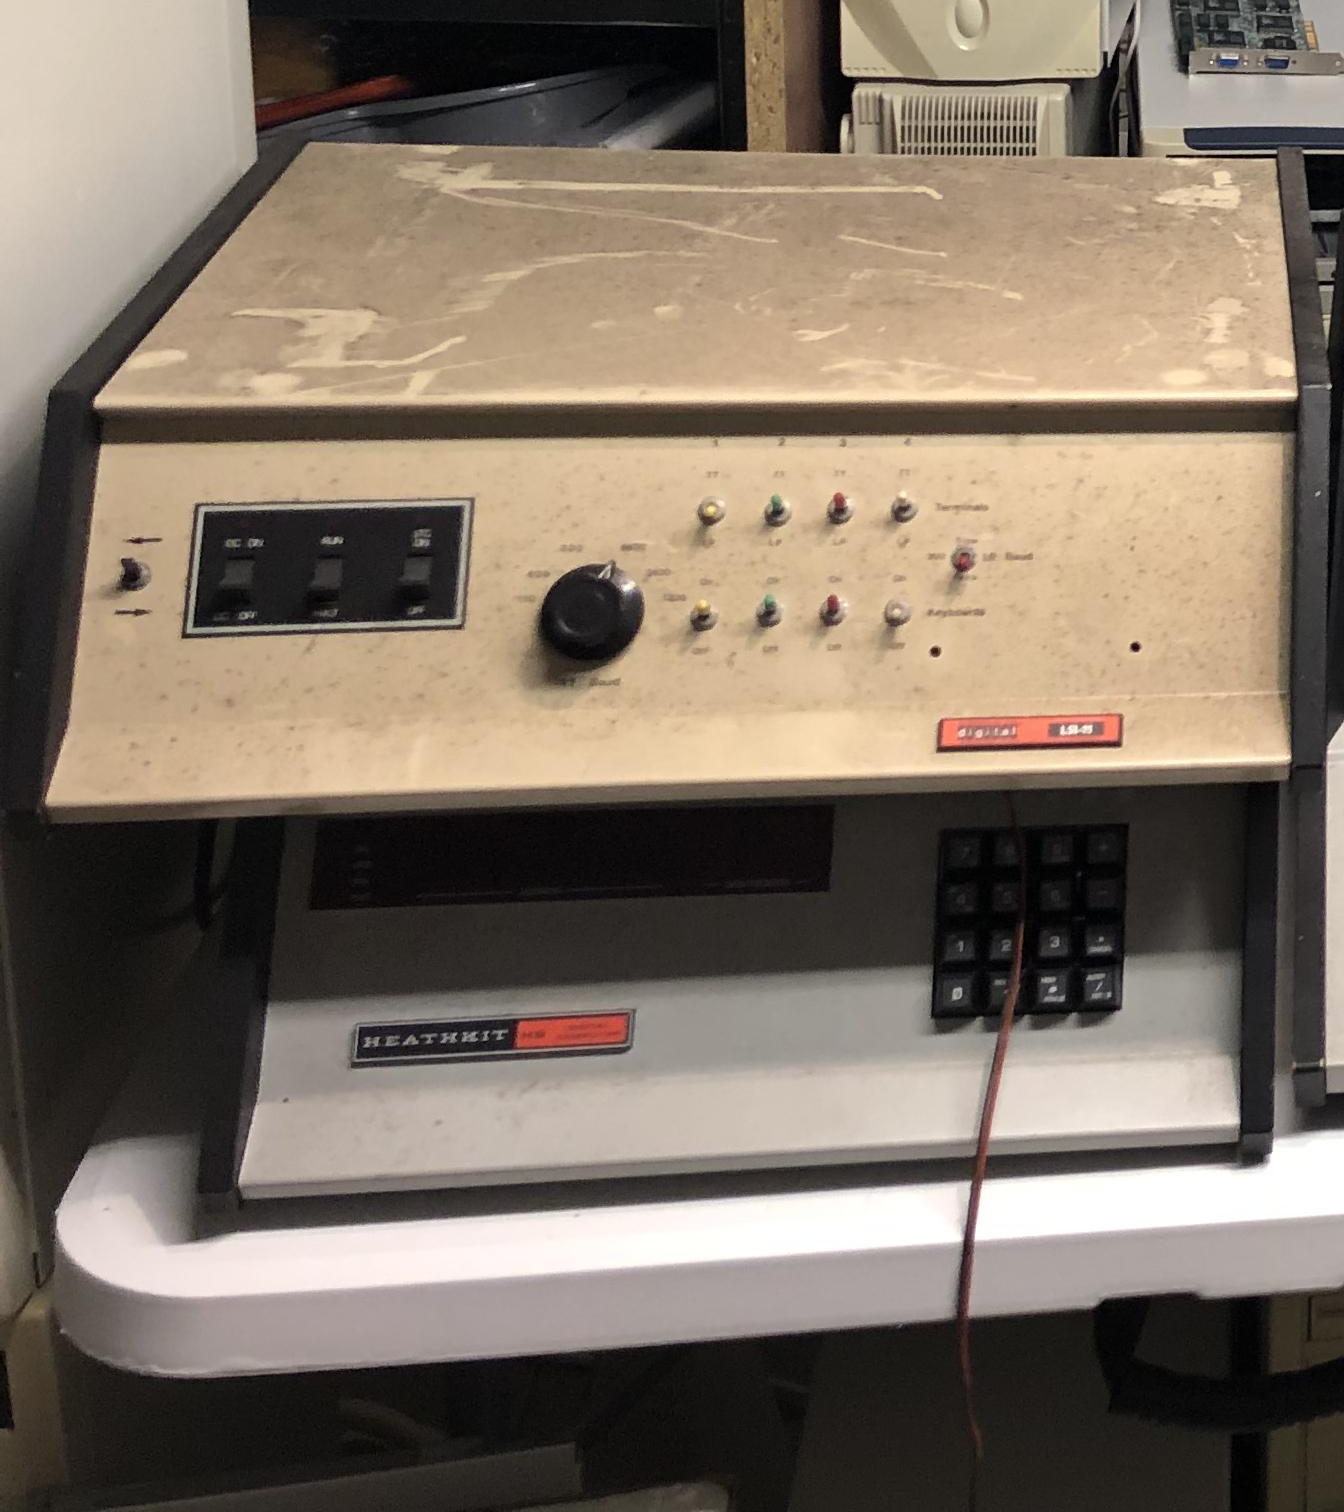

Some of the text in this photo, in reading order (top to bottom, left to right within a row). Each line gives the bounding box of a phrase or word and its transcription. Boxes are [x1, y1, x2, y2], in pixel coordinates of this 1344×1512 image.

[958, 726, 1018, 739] digital
[957, 936, 1060, 952] 1 2 3
[362, 1029, 509, 1048] HEATHKIT
